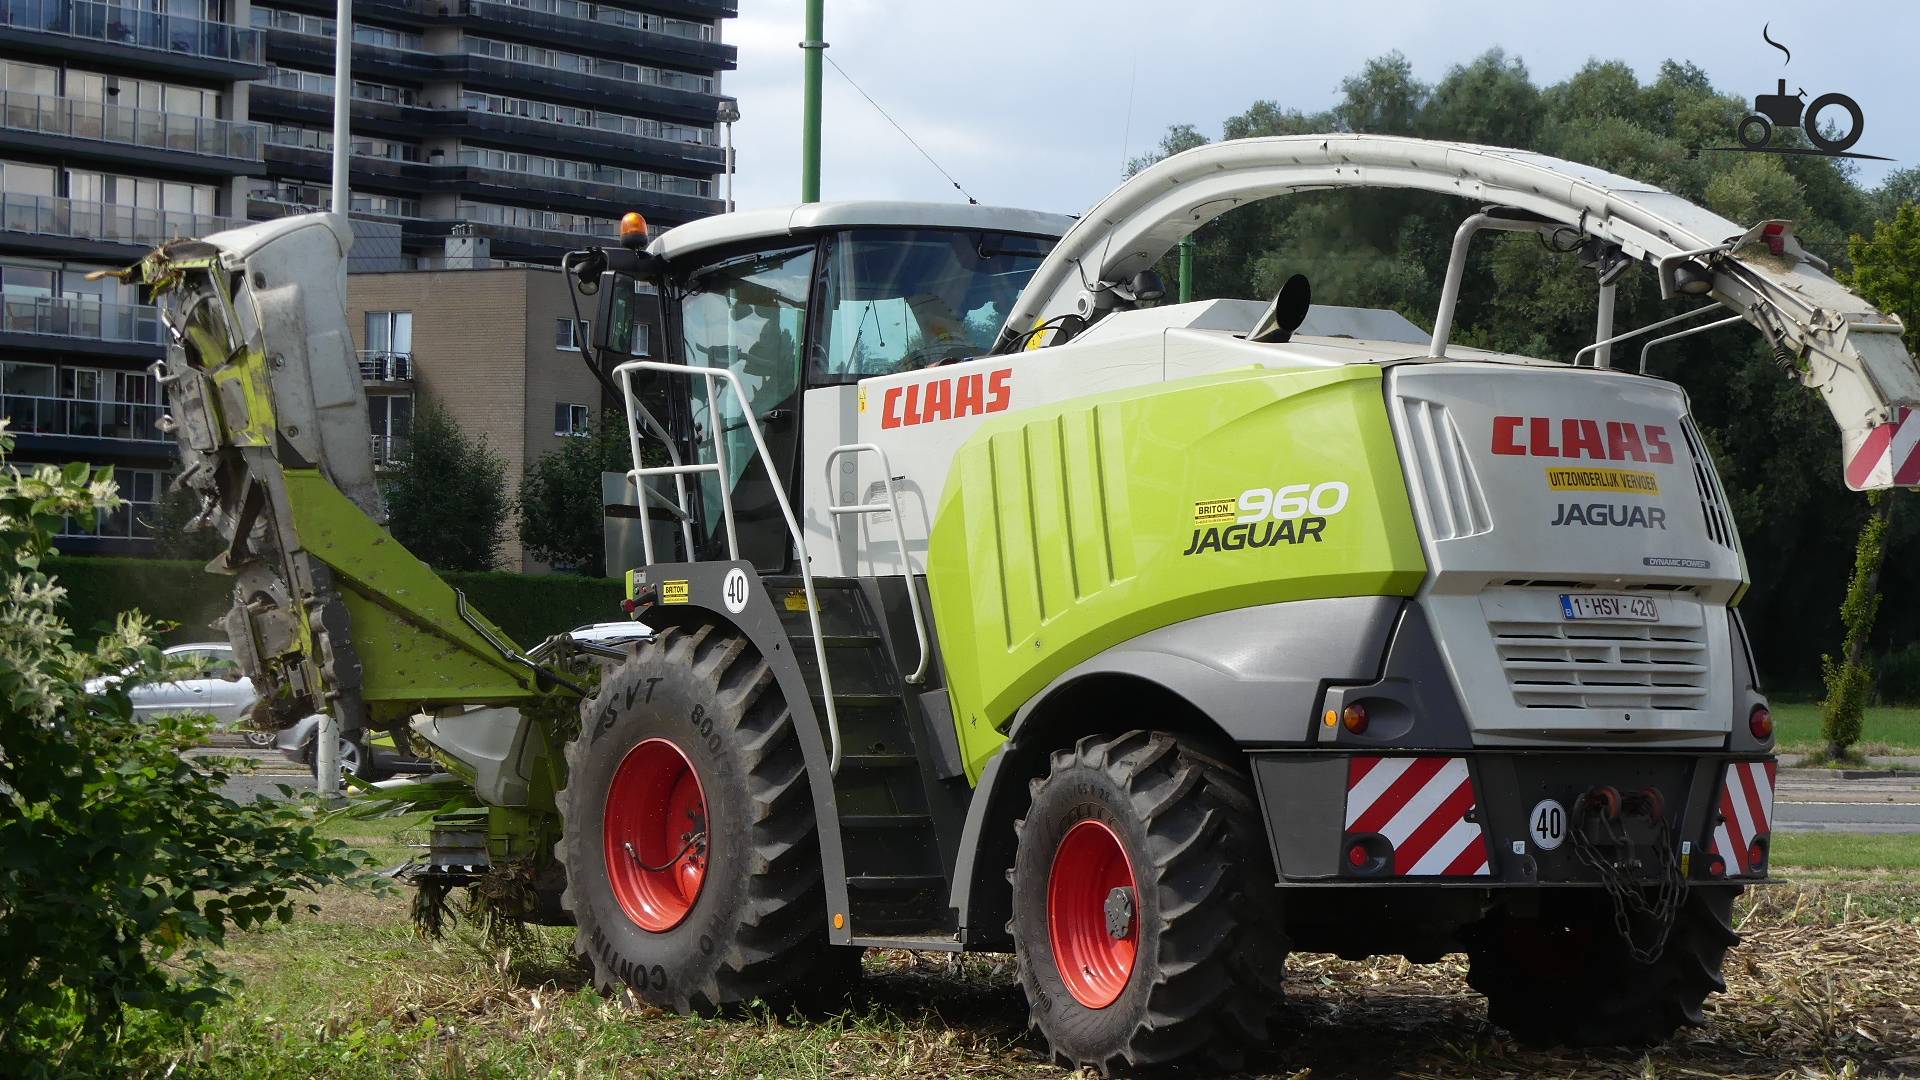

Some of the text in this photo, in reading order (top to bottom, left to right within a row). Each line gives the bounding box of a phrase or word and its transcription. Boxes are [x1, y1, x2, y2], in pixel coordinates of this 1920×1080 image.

[881, 368, 1013, 430] CLAAS
[1491, 416, 1674, 464] CLAAS
[1549, 471, 1658, 491] UITZONDERLIJK VERVOER
[1198, 504, 1229, 515] BRITON
[1236, 481, 1349, 524] 960
[1551, 503, 1666, 531] JAGUAR
[1183, 516, 1327, 556] JAGUAR
[1649, 558, 1706, 568] DYNAMIC POWER
[728, 576, 744, 604] 40
[1536, 808, 1561, 840] 40
